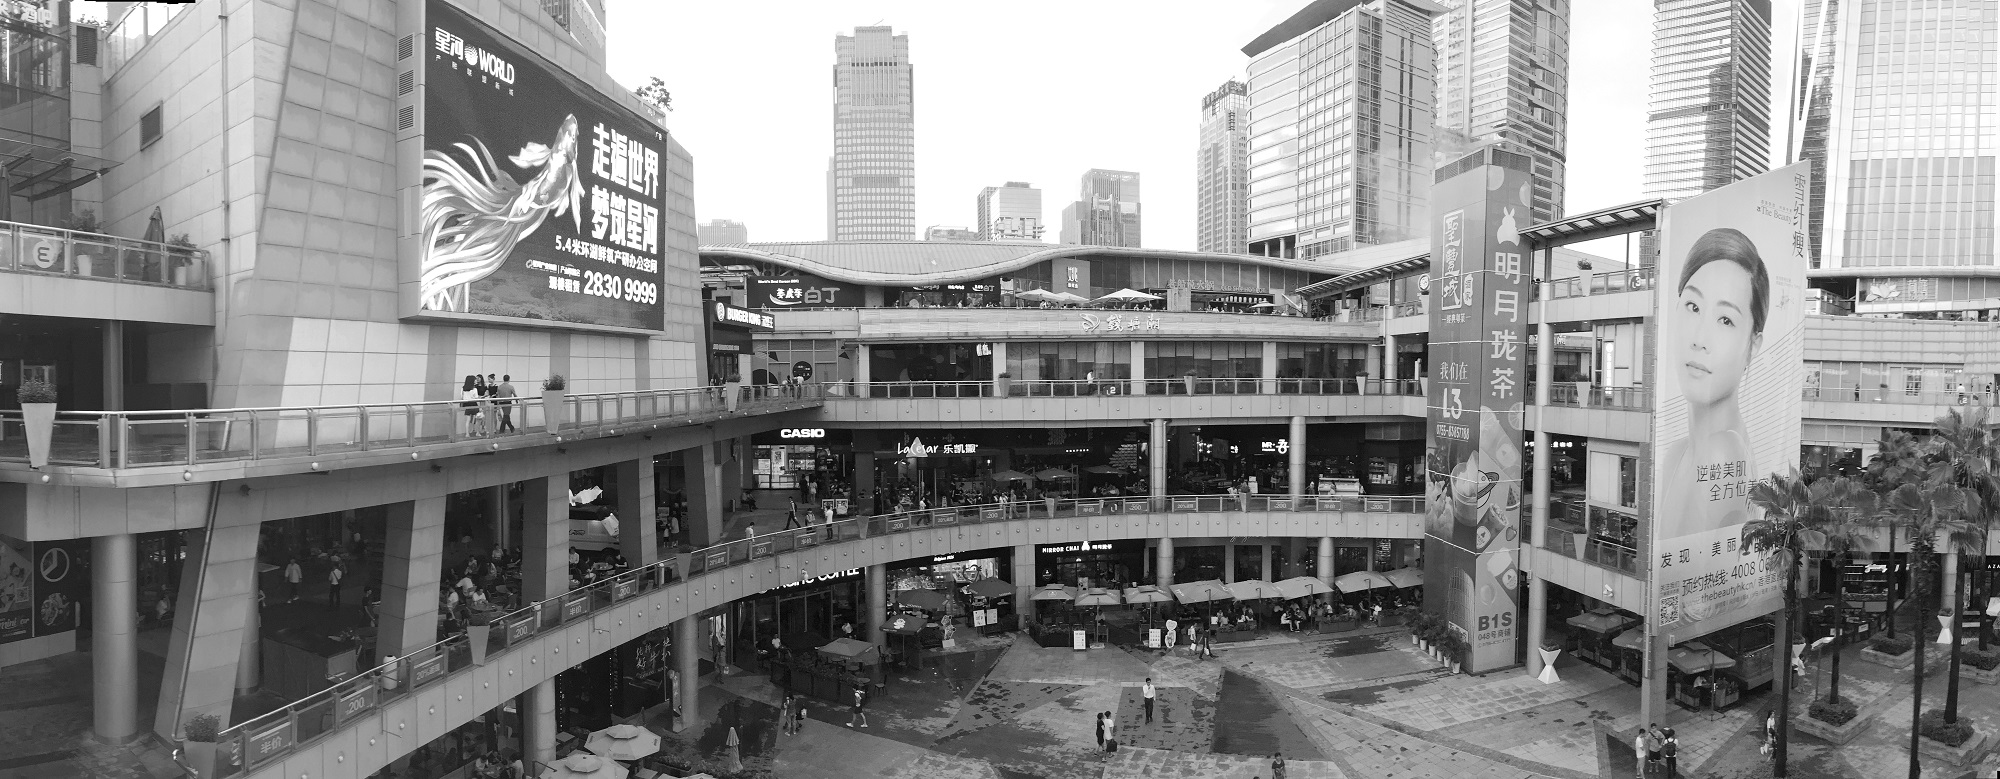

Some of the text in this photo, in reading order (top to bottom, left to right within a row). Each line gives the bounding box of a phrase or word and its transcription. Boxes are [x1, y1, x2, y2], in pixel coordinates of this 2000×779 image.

[435, 27, 515, 85] 星河 WORLD
[592, 122, 659, 200] 走遍世界
[591, 184, 659, 254] 梦筑星河
[583, 270, 622, 300] 2830
[624, 277, 657, 305] 9999
[804, 286, 841, 304] 白丁
[726, 307, 748, 322] BURGER
[748, 311, 761, 326] KING
[1490, 252, 1521, 399] 明月珑茶
[1440, 361, 1468, 381] 我们在
[1443, 387, 1463, 420] L3
[780, 428, 826, 439] CASIO
[1696, 460, 1747, 483] 逆龄美肌
[1731, 561, 1756, 580] 4008
[1478, 611, 1513, 632] B1S
